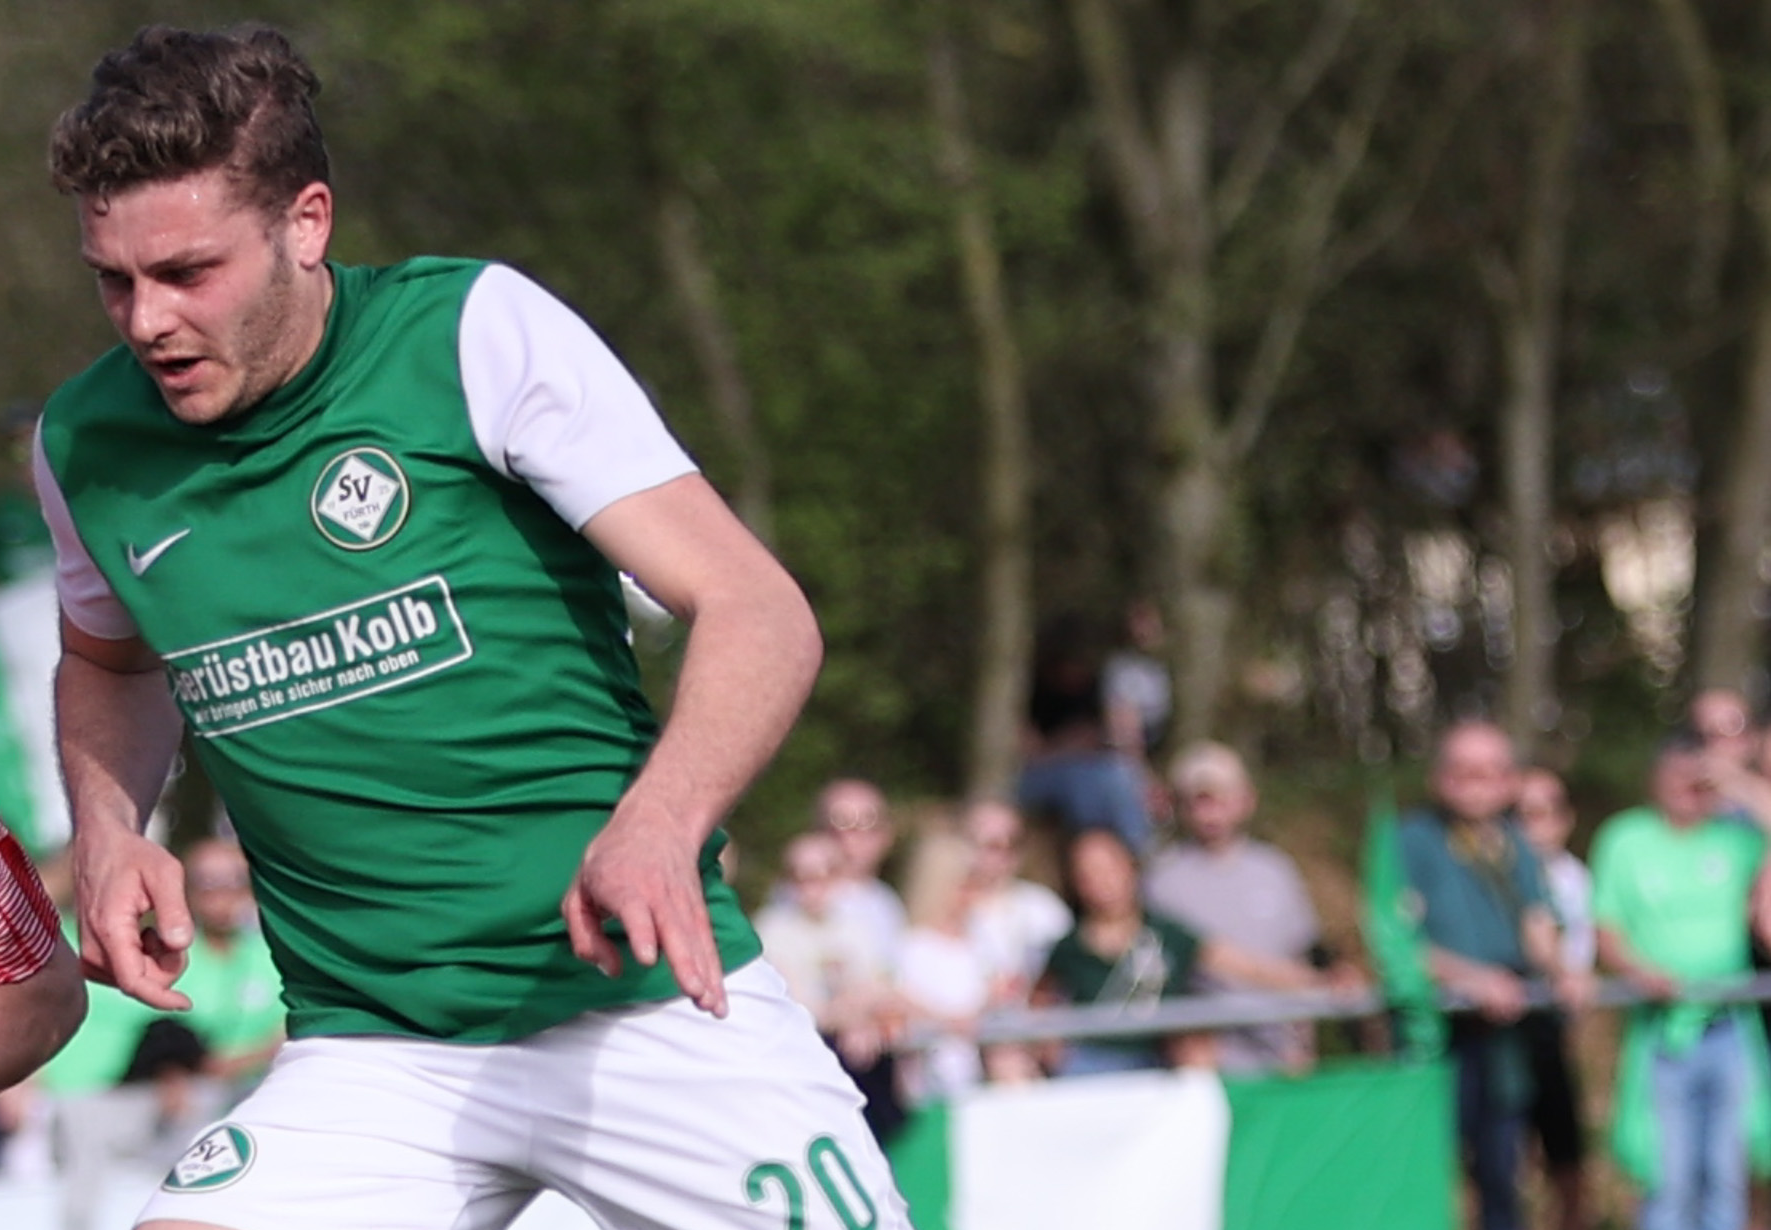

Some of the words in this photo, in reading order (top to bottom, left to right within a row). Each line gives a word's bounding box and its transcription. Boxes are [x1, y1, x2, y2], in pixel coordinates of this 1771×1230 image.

[339, 474, 372, 502] SV
[173, 632, 336, 703] erüstbau
[334, 596, 437, 663] Kolb
[210, 698, 258, 722] bringen
[259, 690, 285, 709] Sie
[287, 676, 333, 701] sicher
[337, 663, 375, 687] nach
[379, 649, 419, 675] oben
